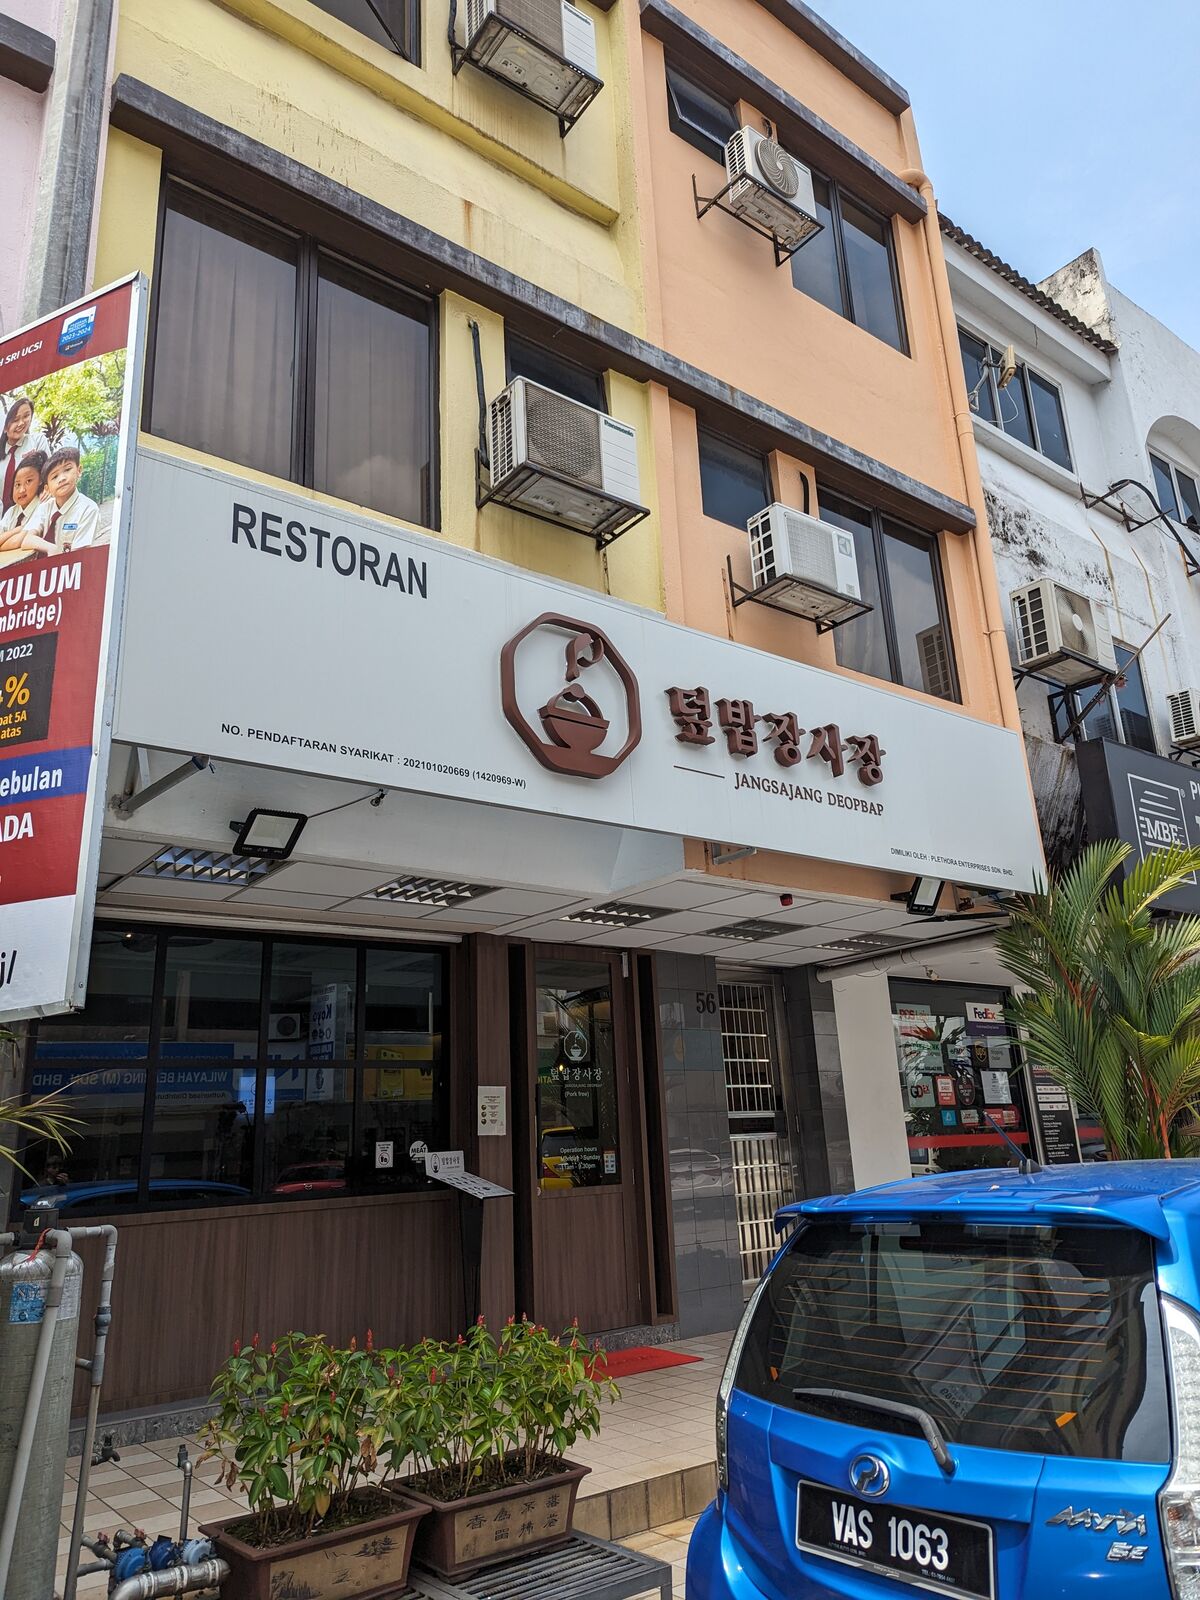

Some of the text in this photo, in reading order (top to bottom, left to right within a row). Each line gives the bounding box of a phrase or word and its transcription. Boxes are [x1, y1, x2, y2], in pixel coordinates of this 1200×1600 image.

[4, 350, 20, 365] SRI
[21, 340, 43, 357] UCSI
[231, 502, 428, 600] RESTORAN
[6, 643, 33, 661] 2022
[14, 709, 27, 723] 5A
[664, 685, 887, 788] 덮밥장사장
[221, 723, 244, 737] NO.
[247, 728, 337, 753] PENDAFTARAN
[340, 745, 394, 764] SYARIKAT
[403, 757, 470, 778] 202101020669
[472, 770, 527, 789] (1420969-W)
[0, 766, 63, 797] ebulan
[734, 772, 884, 817] JANGSAJANG DEOPBAP
[1144, 817, 1181, 846] MBE
[890, 847, 912, 857] DIMILIKI
[912, 852, 927, 861] OLEH
[931, 855, 958, 866] PLETHORA
[958, 860, 992, 872] ENTERPRISES
[1002, 868, 1015, 876] BHD.
[696, 991, 716, 1015] 56
[974, 1007, 996, 1020] FedEx
[550, 1067, 603, 1081] 덮밥장사장
[832, 1501, 949, 1571] VAS 1063
